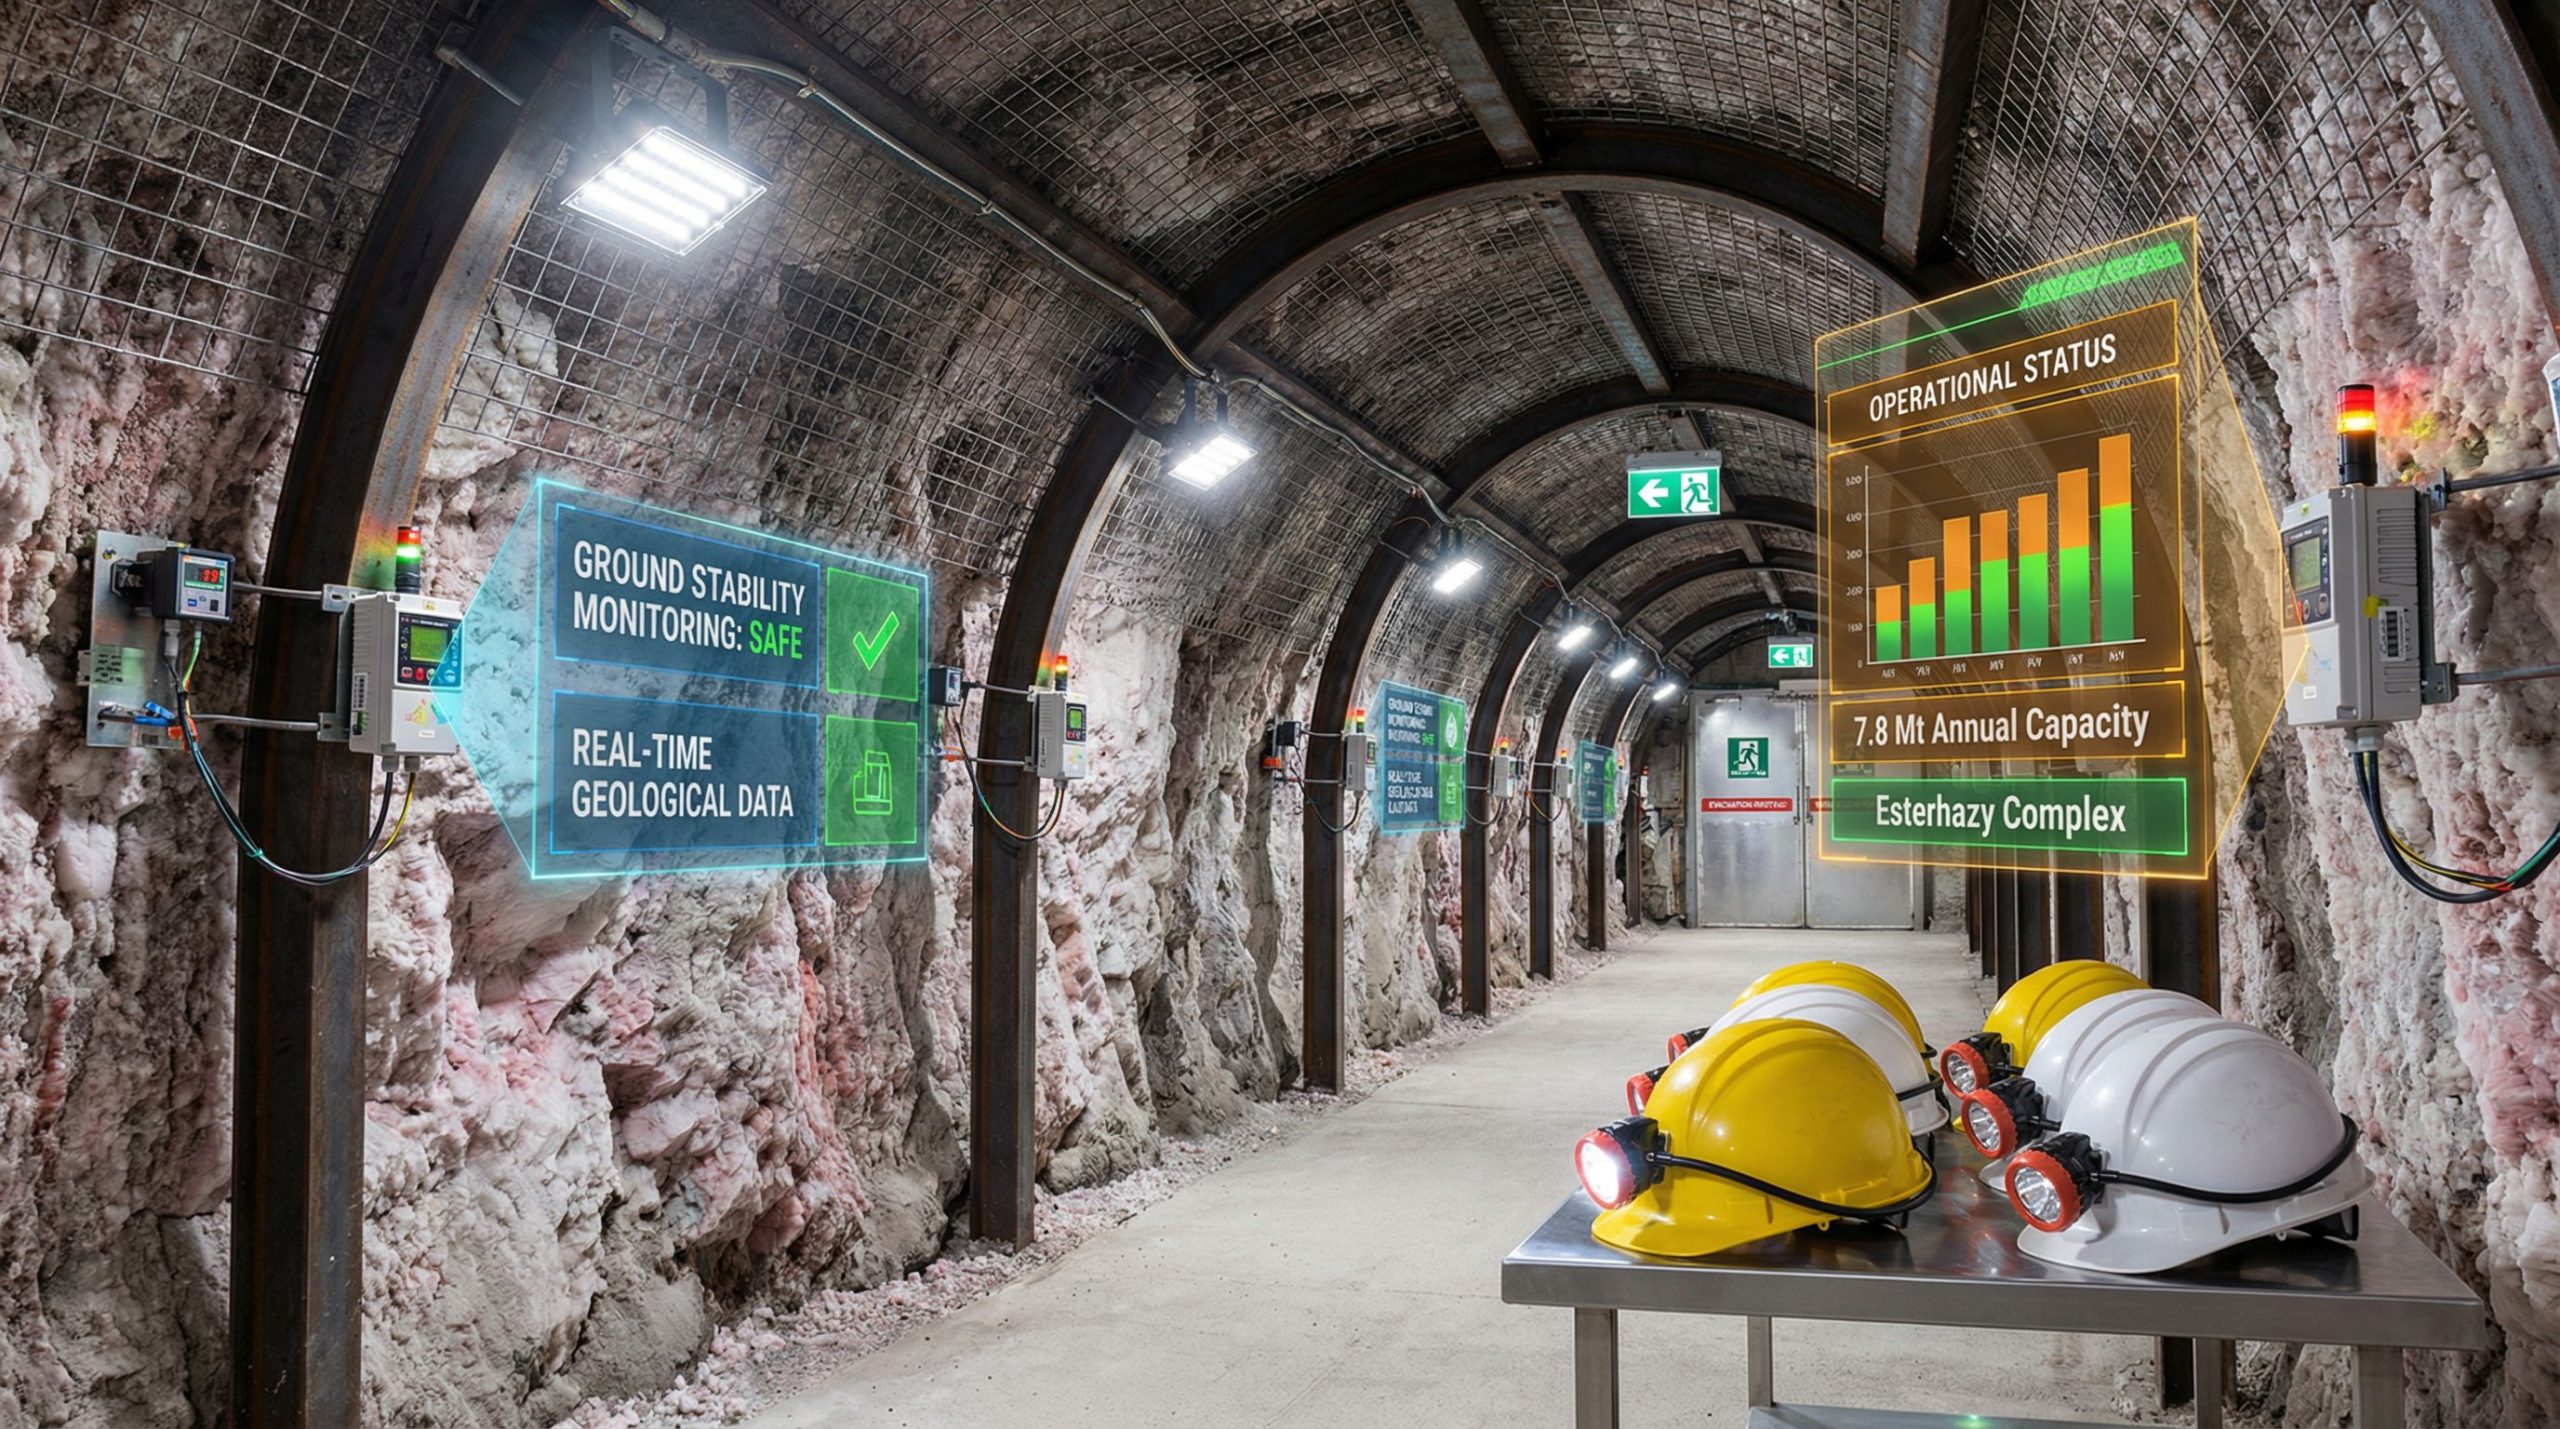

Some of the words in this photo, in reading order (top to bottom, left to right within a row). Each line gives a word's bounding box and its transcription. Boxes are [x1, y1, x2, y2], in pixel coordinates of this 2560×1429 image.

[1869, 361, 2017, 422] OPERATIONAL
[2023, 333, 2117, 383] STATUS
[573, 540, 684, 594] GROUND
[691, 564, 805, 616] STABILITY
[573, 591, 743, 651] MONITORING:
[749, 620, 803, 660] SAFE
[1854, 714, 1888, 746] 7.8
[1895, 713, 1925, 745] Mt
[1932, 707, 2017, 744] Annual
[2025, 702, 2150, 748] Capacity
[573, 728, 712, 771] REAL-TIME
[572, 778, 731, 817] GEOLOGICAL
[738, 783, 794, 817] DATA
[1876, 793, 1995, 838] Esterhazy
[2003, 794, 2126, 840] Complex
